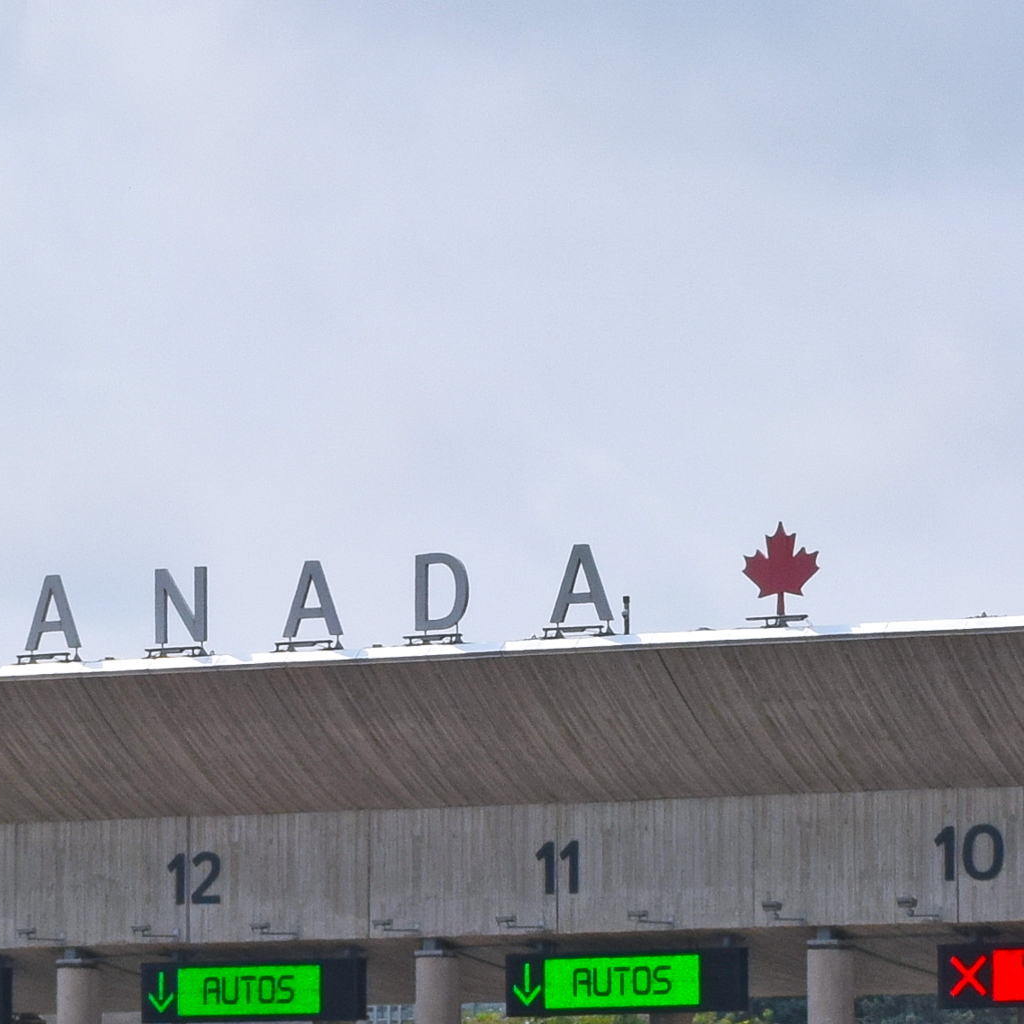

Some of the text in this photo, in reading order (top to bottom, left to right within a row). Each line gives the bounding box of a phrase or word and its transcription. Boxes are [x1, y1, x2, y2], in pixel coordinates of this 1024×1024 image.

[167, 851, 222, 906] 12
[536, 839, 580, 895] 11
[934, 823, 1005, 881] 10
[202, 974, 295, 1006] AUTOS
[572, 964, 673, 997] AUTOS
